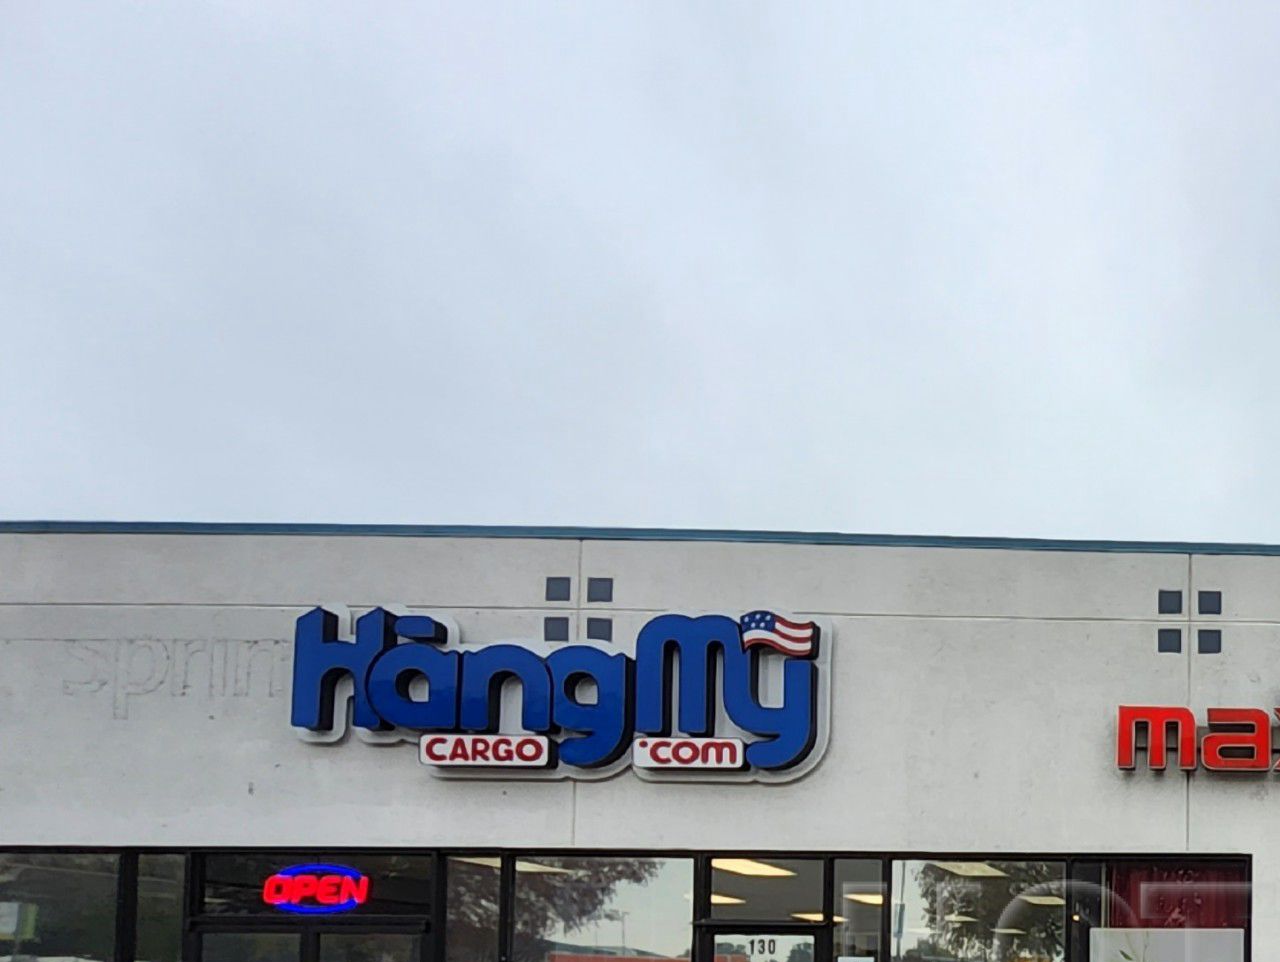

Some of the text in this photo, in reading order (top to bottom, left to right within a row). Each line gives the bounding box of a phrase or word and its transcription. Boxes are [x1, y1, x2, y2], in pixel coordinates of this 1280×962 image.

[425, 737, 543, 762] CARGO
[262, 874, 369, 905] OPEN
[748, 939, 777, 956] 130
